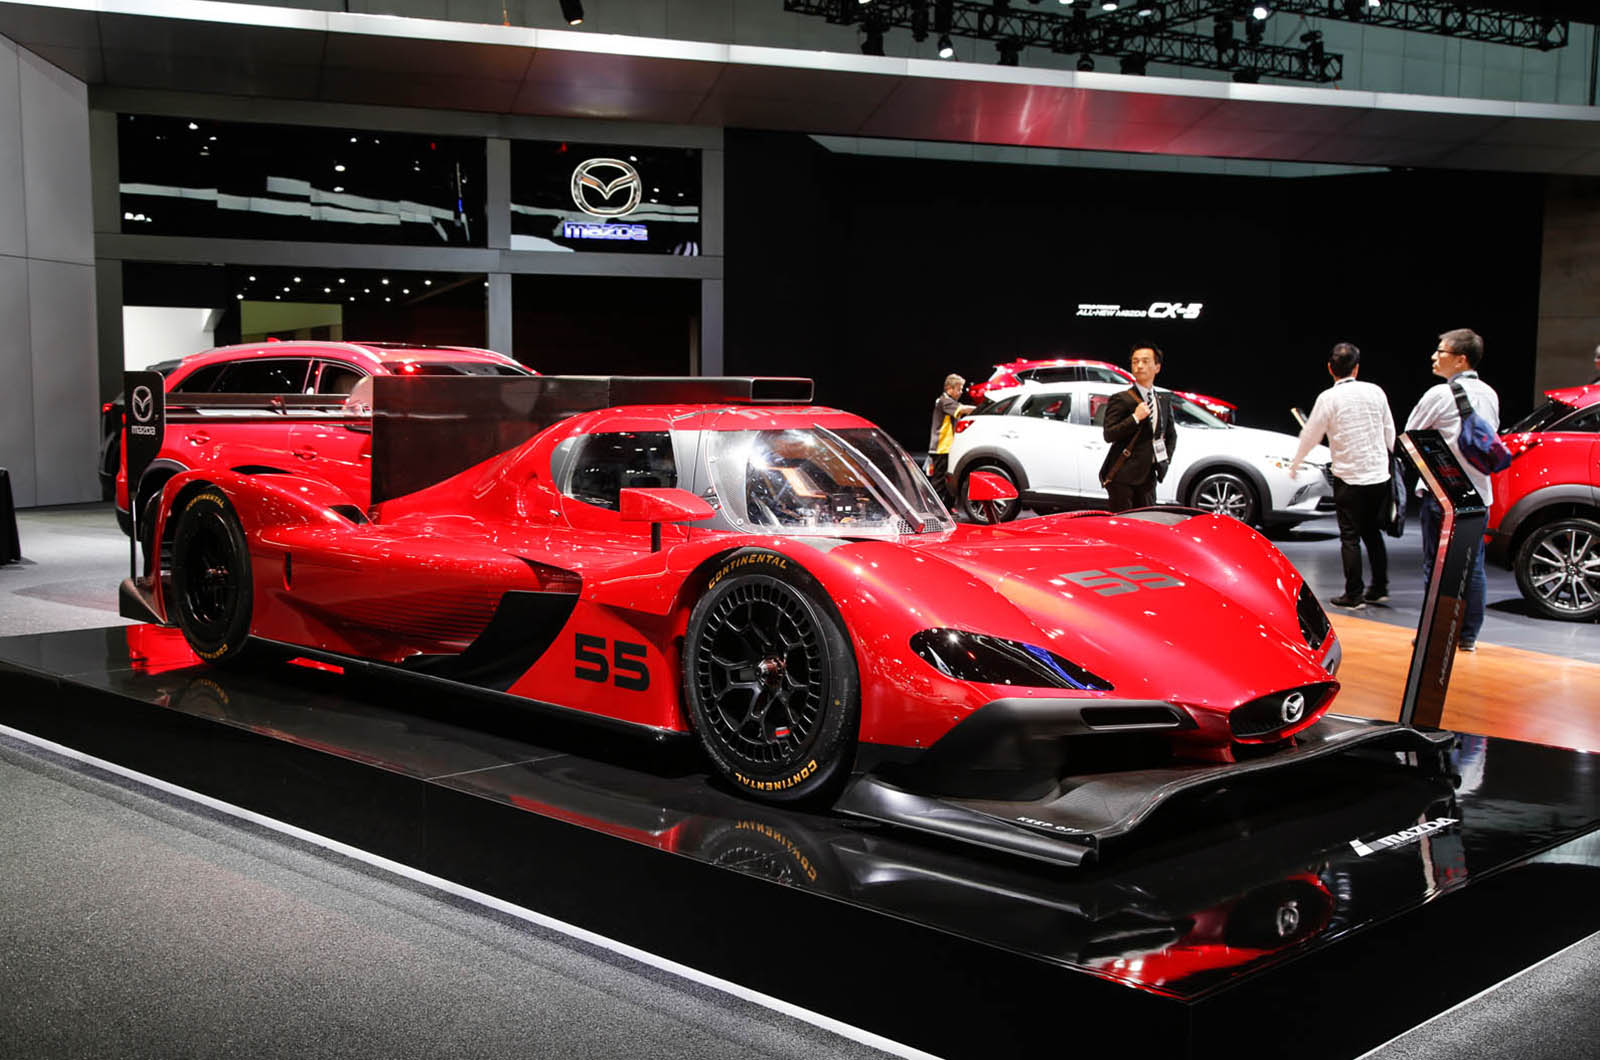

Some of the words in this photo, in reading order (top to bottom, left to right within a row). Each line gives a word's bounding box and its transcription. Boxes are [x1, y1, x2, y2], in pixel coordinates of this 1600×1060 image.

[1148, 302, 1203, 319] CX-5
[708, 554, 787, 590] CONTINENTAL
[1058, 565, 1184, 596] 55
[575, 632, 650, 692] 55
[735, 759, 818, 790] CONTINENTAL
[1016, 816, 1053, 827] KEEP
